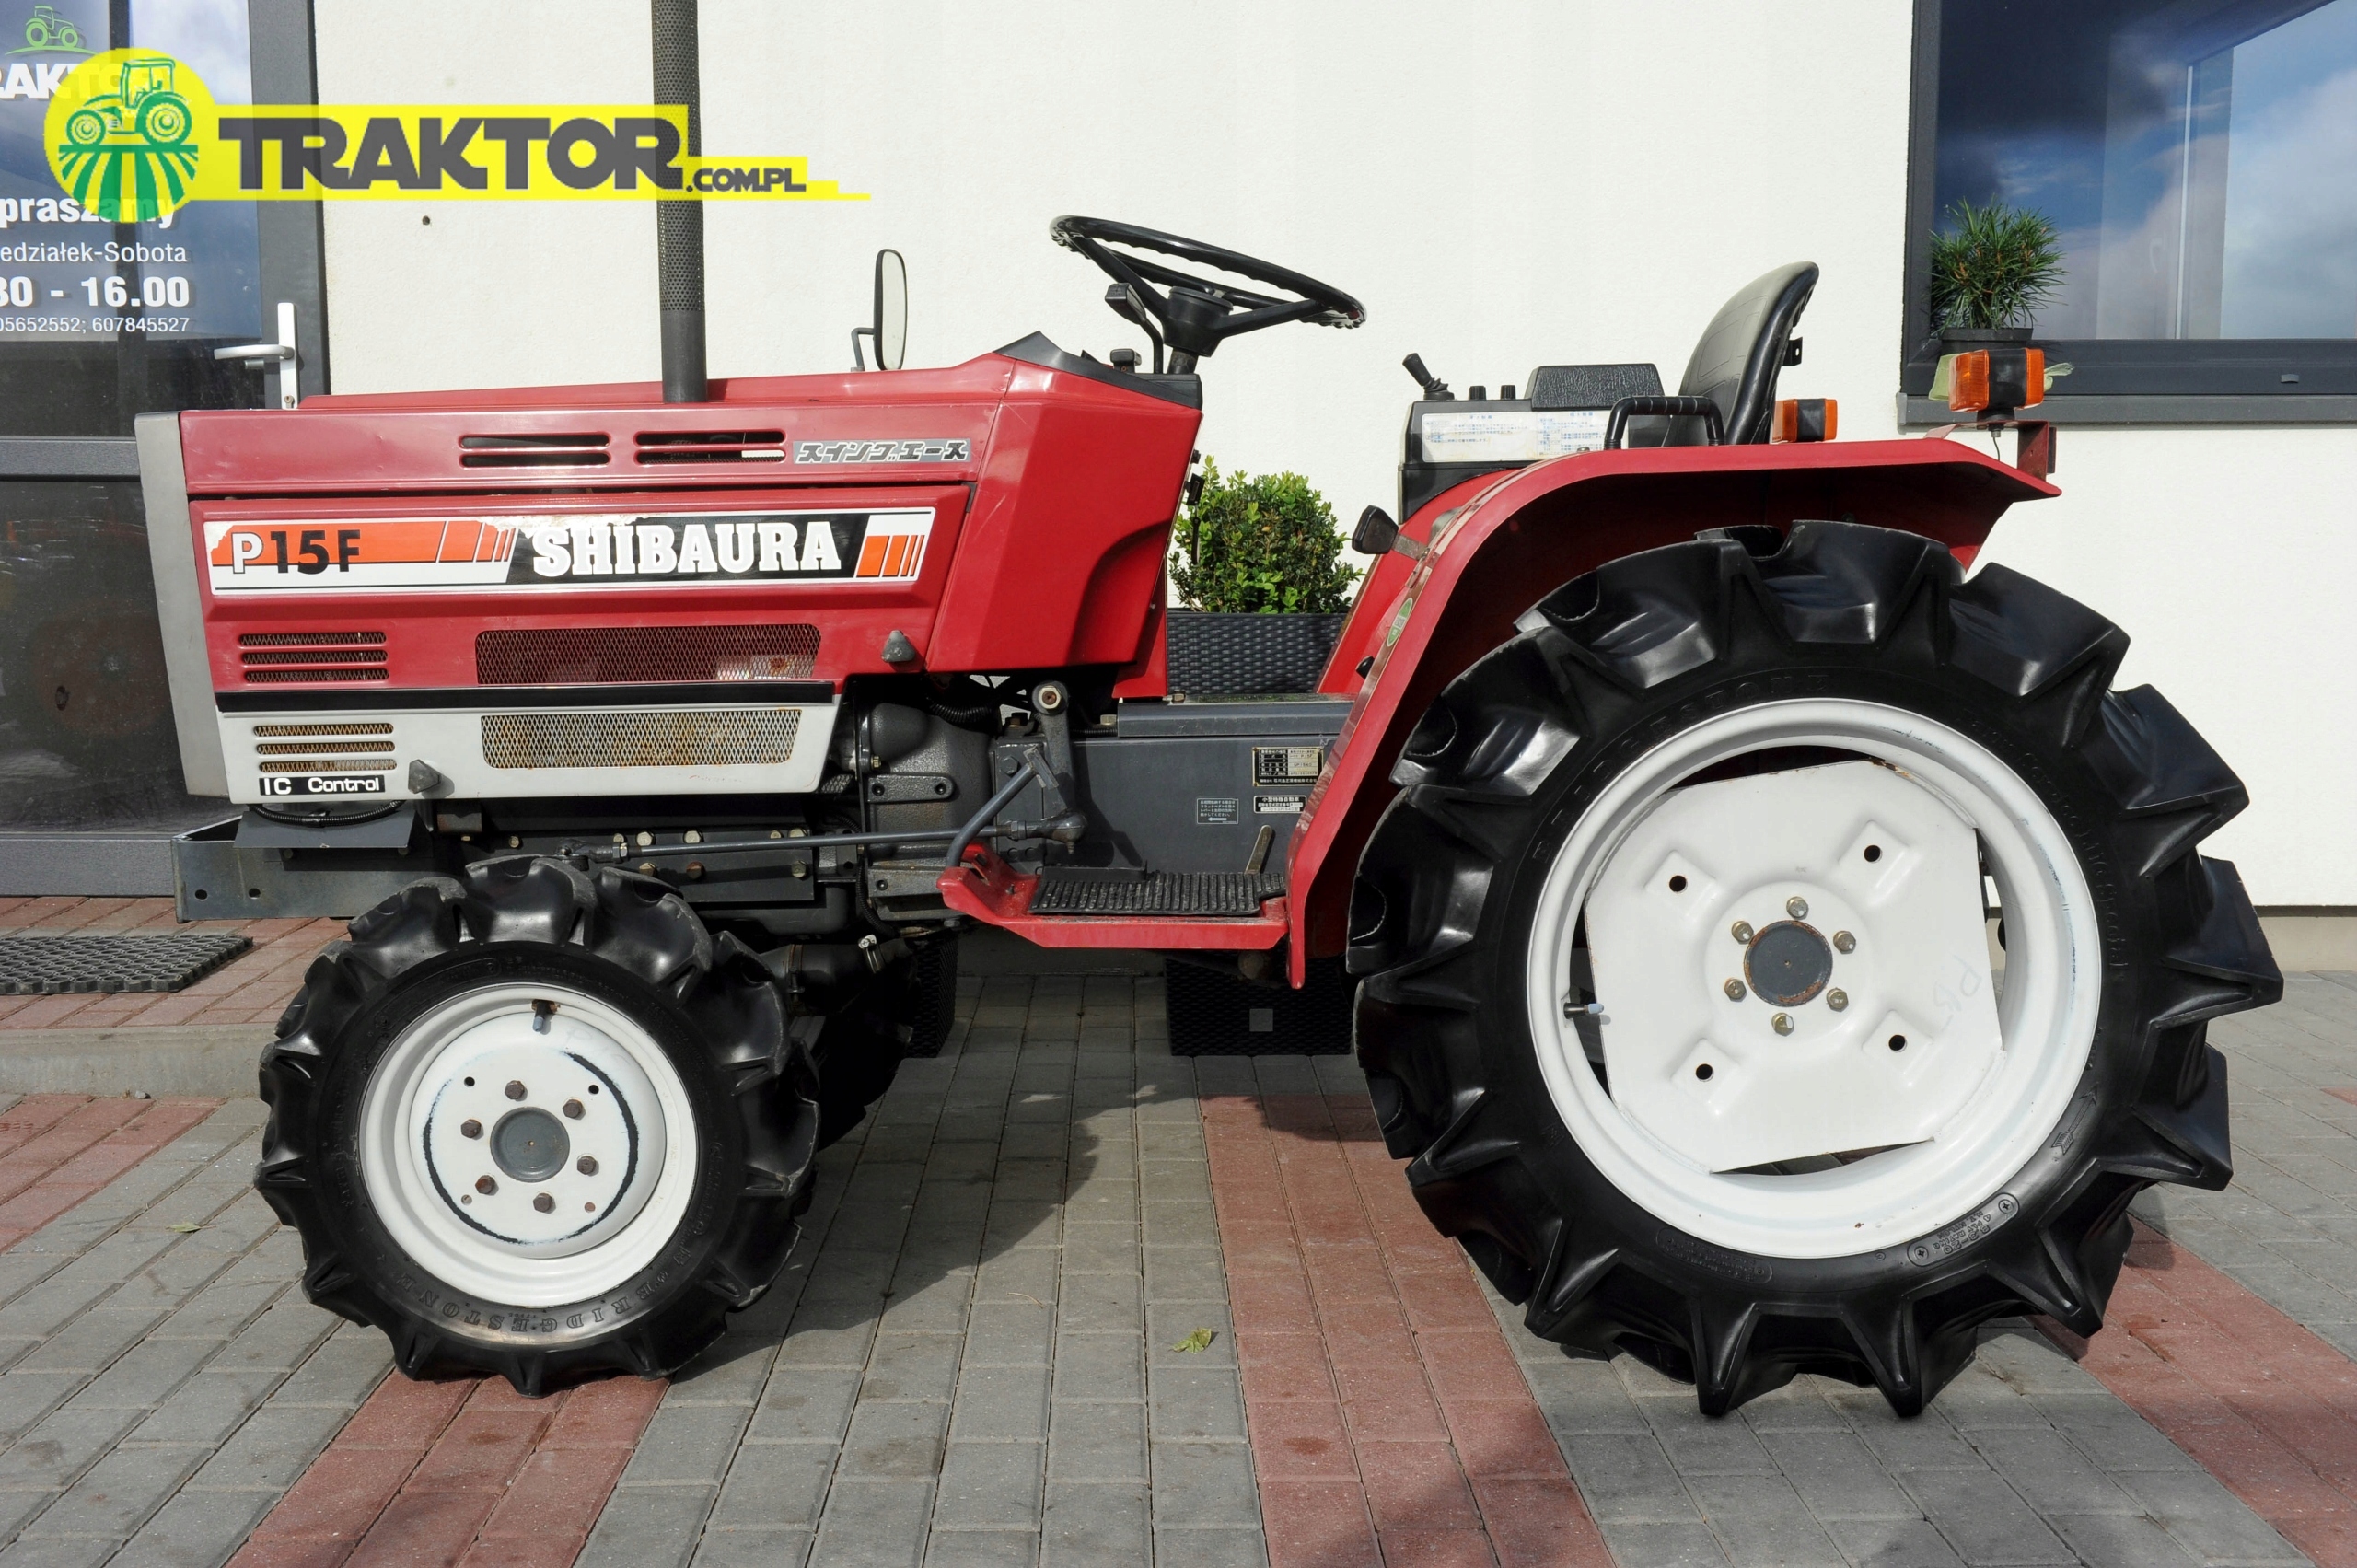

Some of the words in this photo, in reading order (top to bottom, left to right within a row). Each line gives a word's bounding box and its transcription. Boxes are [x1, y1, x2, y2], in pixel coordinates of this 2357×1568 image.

[0, 241, 187, 262] edziałek-Sobota
[81, 276, 190, 307] 16.00
[92, 318, 190, 332] 607845527
[795, 440, 968, 463] スイングエース
[230, 528, 361, 575] P15F
[531, 520, 842, 577] SHIBAURA
[263, 777, 292, 796] IC
[308, 776, 380, 793] Control
[1933, 1230, 1966, 1250] RATING
[1943, 1224, 1991, 1255] 8.3-20
